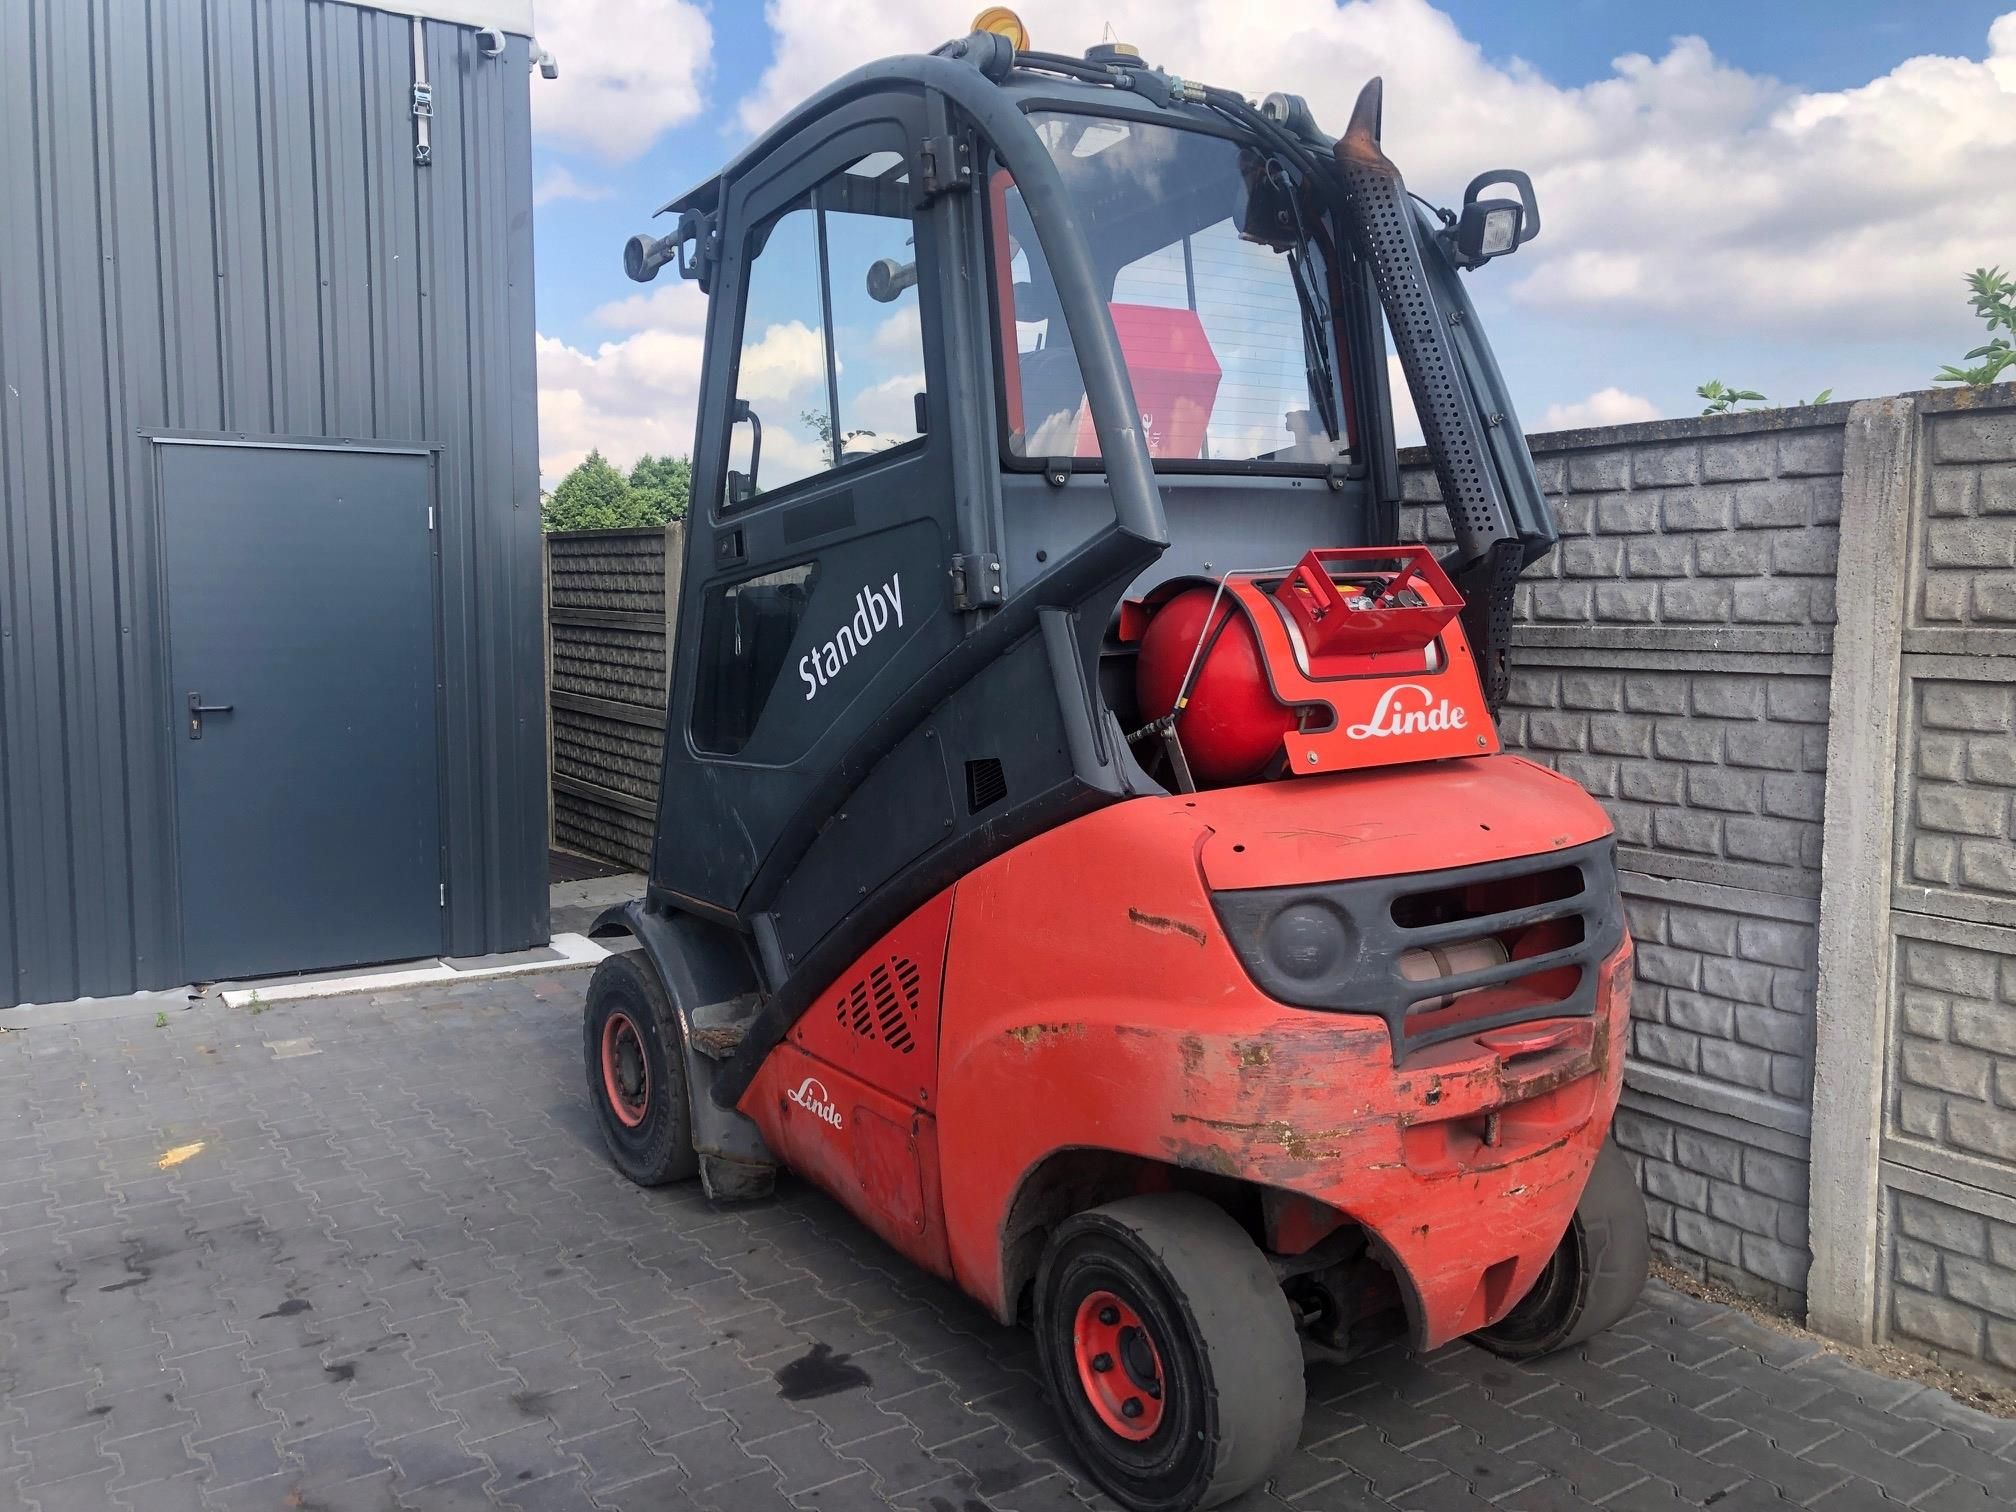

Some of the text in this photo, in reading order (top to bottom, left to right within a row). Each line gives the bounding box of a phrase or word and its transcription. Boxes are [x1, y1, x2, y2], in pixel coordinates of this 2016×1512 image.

[799, 572, 904, 701] Standby
[1346, 684, 1468, 740] Linde
[787, 1077, 843, 1130] Linde
